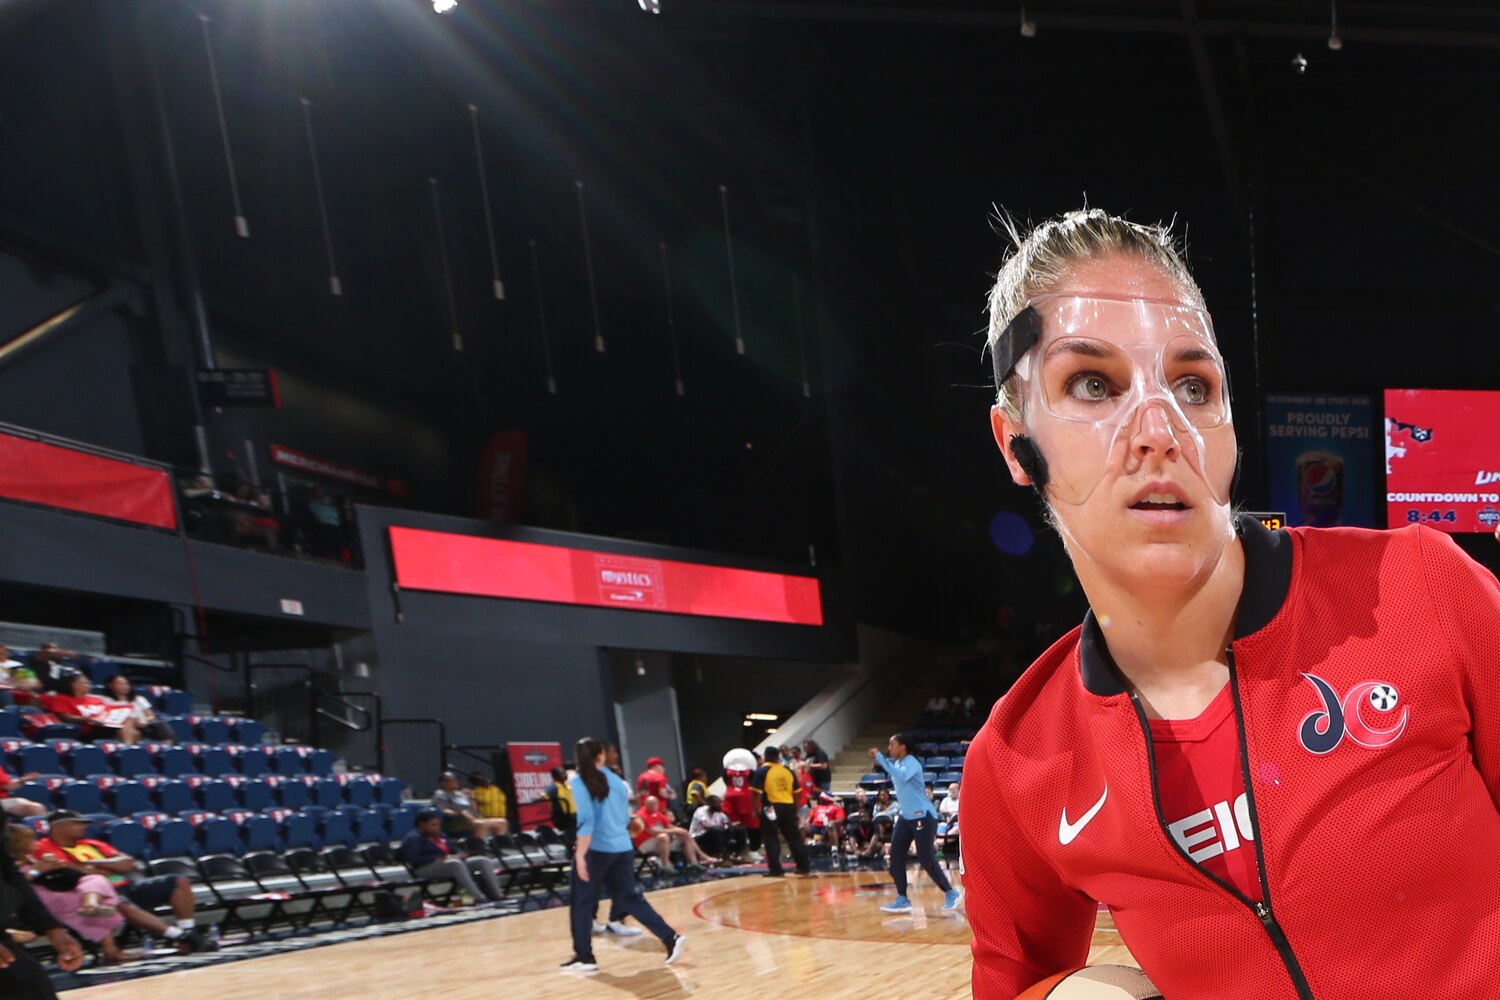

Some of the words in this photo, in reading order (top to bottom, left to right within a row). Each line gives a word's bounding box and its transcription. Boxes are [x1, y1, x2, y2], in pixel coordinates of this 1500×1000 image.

[1287, 412, 1351, 425] PROUDLY
[1269, 425, 1329, 438] SERVING
[1331, 426, 1369, 439] PEPSI
[1386, 493, 1478, 503] COUNTDOWN
[1480, 493, 1500, 503] TO
[1406, 509, 1457, 523] 8:44
[513, 772, 554, 789] SIDELIN
